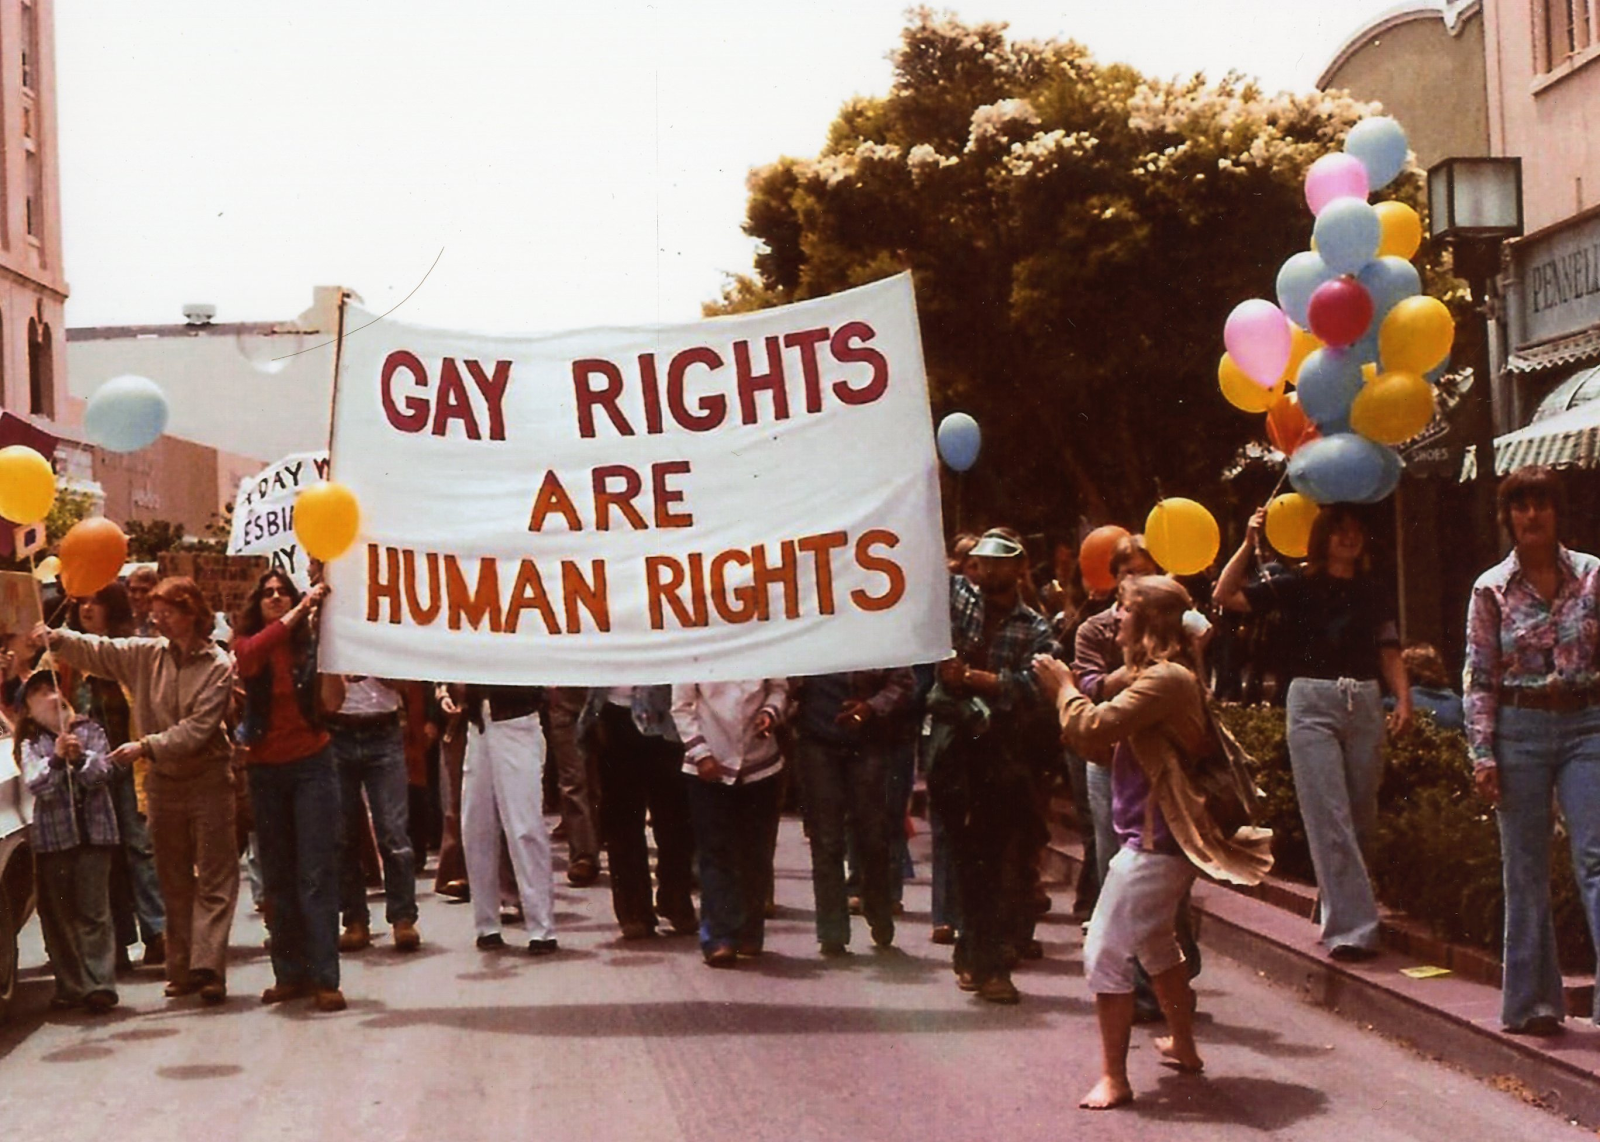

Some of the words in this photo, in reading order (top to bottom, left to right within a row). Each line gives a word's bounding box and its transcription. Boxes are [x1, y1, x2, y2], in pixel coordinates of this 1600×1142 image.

[381, 350, 510, 440] GAY
[572, 322, 888, 438] RIGHTS
[259, 461, 302, 499] DAY
[529, 462, 693, 532] ARE
[367, 543, 610, 635] HUMAN
[645, 530, 906, 630] RIGHTS
